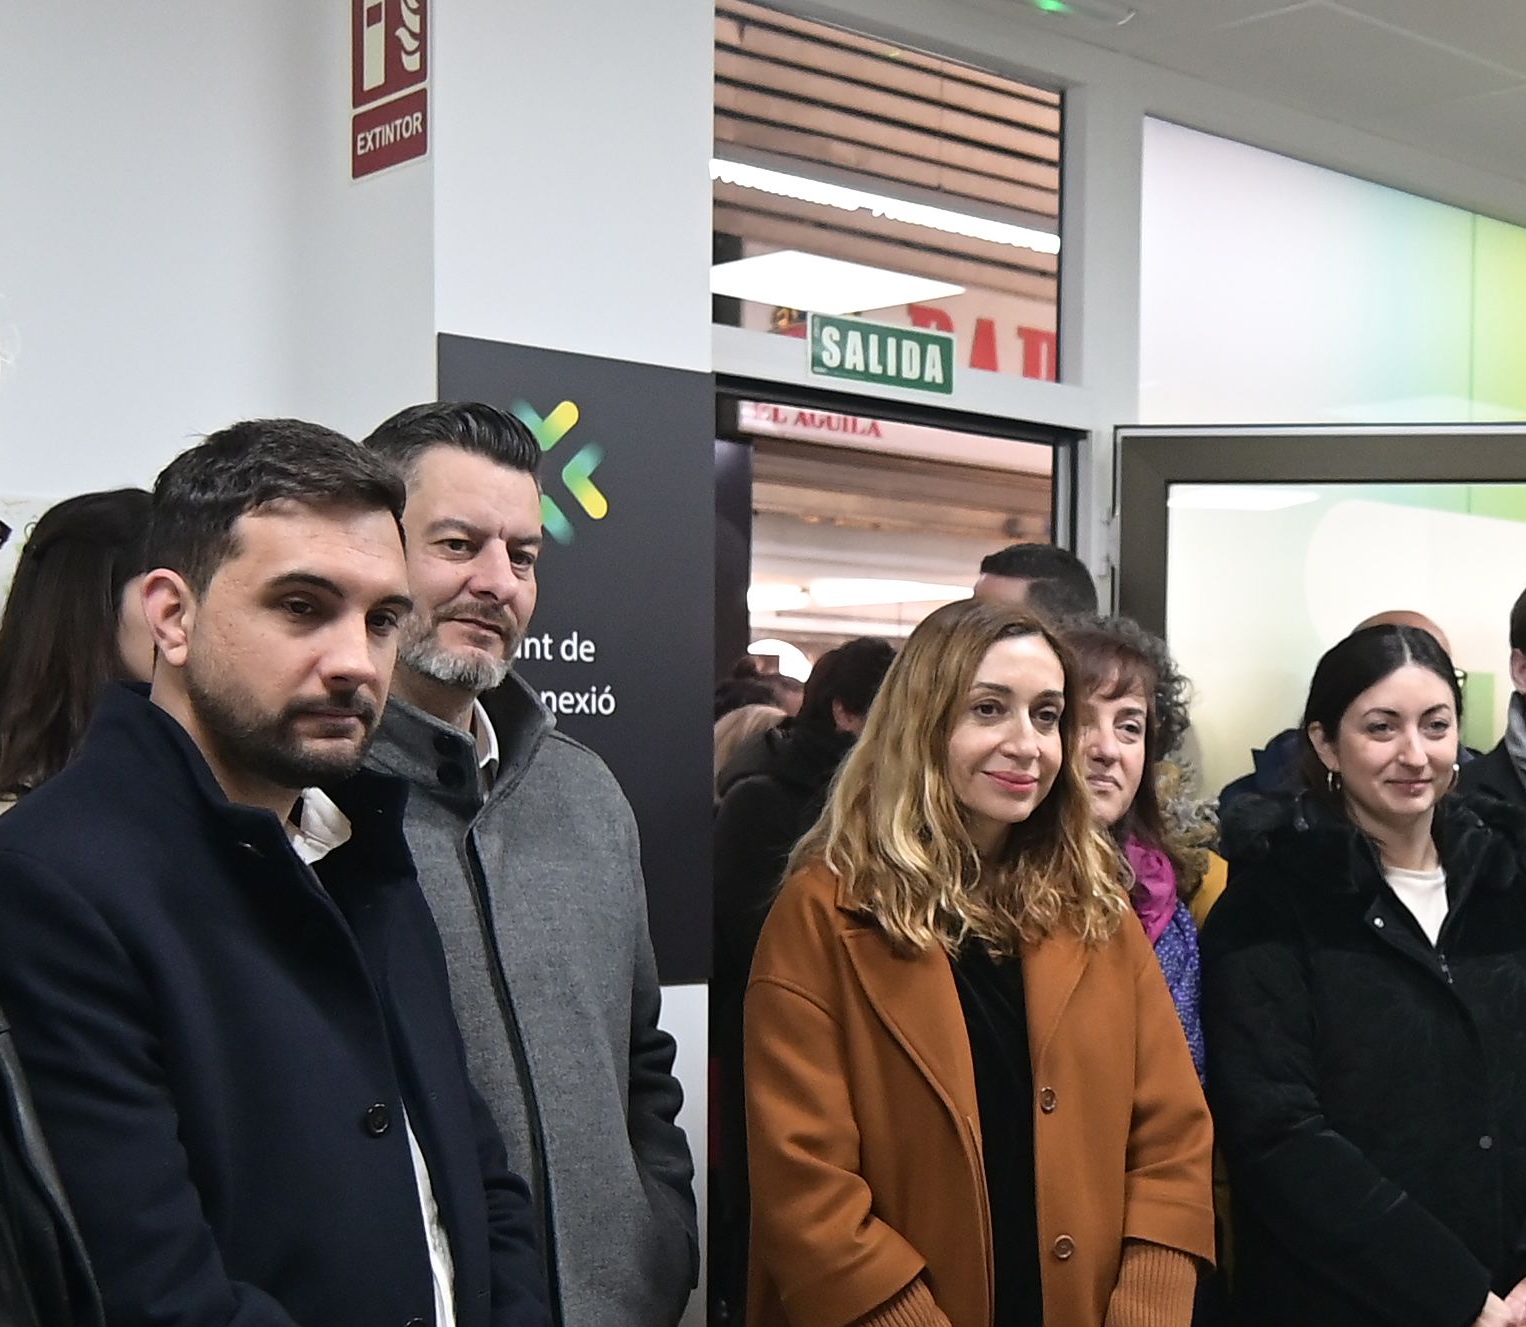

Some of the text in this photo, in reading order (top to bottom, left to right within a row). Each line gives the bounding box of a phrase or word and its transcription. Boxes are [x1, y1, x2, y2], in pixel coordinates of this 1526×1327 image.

[357, 112, 423, 156] EXTINTOR
[821, 325, 944, 384] SALIDA
[560, 631, 595, 662] de
